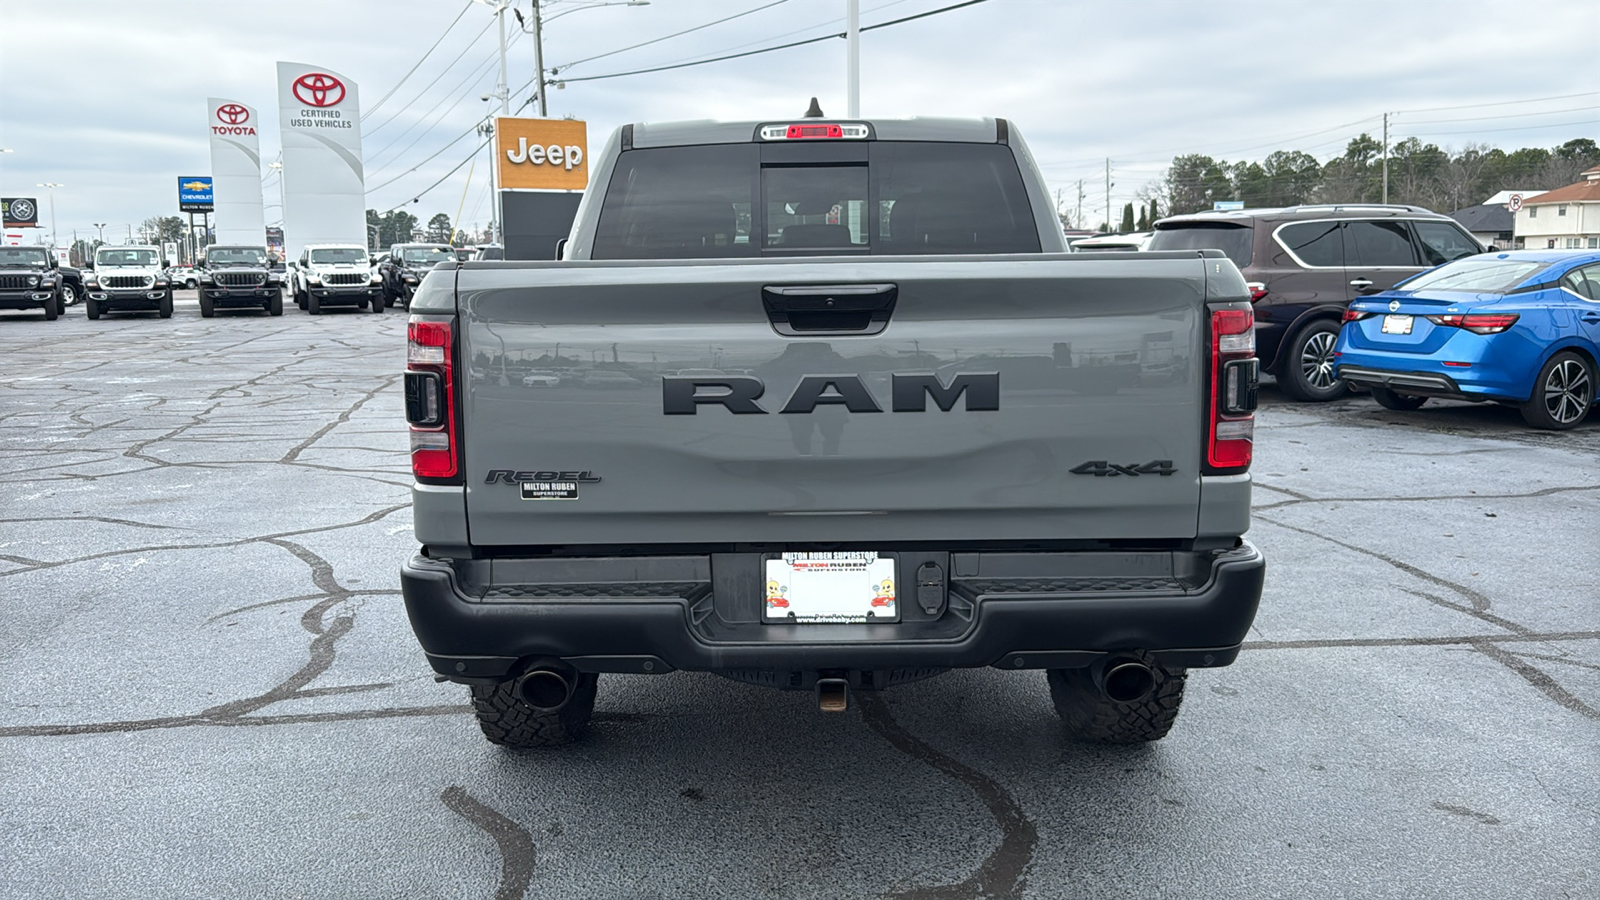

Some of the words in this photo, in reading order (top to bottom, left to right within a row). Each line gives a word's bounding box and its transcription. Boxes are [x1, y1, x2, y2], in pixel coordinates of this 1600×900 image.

[300, 109, 341, 119] CERTIFIED
[290, 118, 313, 127] USED
[314, 119, 352, 129] VEHICLES
[211, 126, 257, 136] TOYOTA
[506, 137, 583, 171] Jeep
[662, 371, 1001, 416] RAM
[1068, 459, 1179, 477] 4x4
[484, 469, 603, 485] REBEL
[523, 482, 550, 491] MILTON
[551, 482, 576, 491] RUBEN
[782, 551, 808, 560] MILTON
[809, 551, 832, 560] RUBEN
[833, 551, 878, 560] SUPERSTORE
[796, 616, 867, 624] www.drivebaby.com
